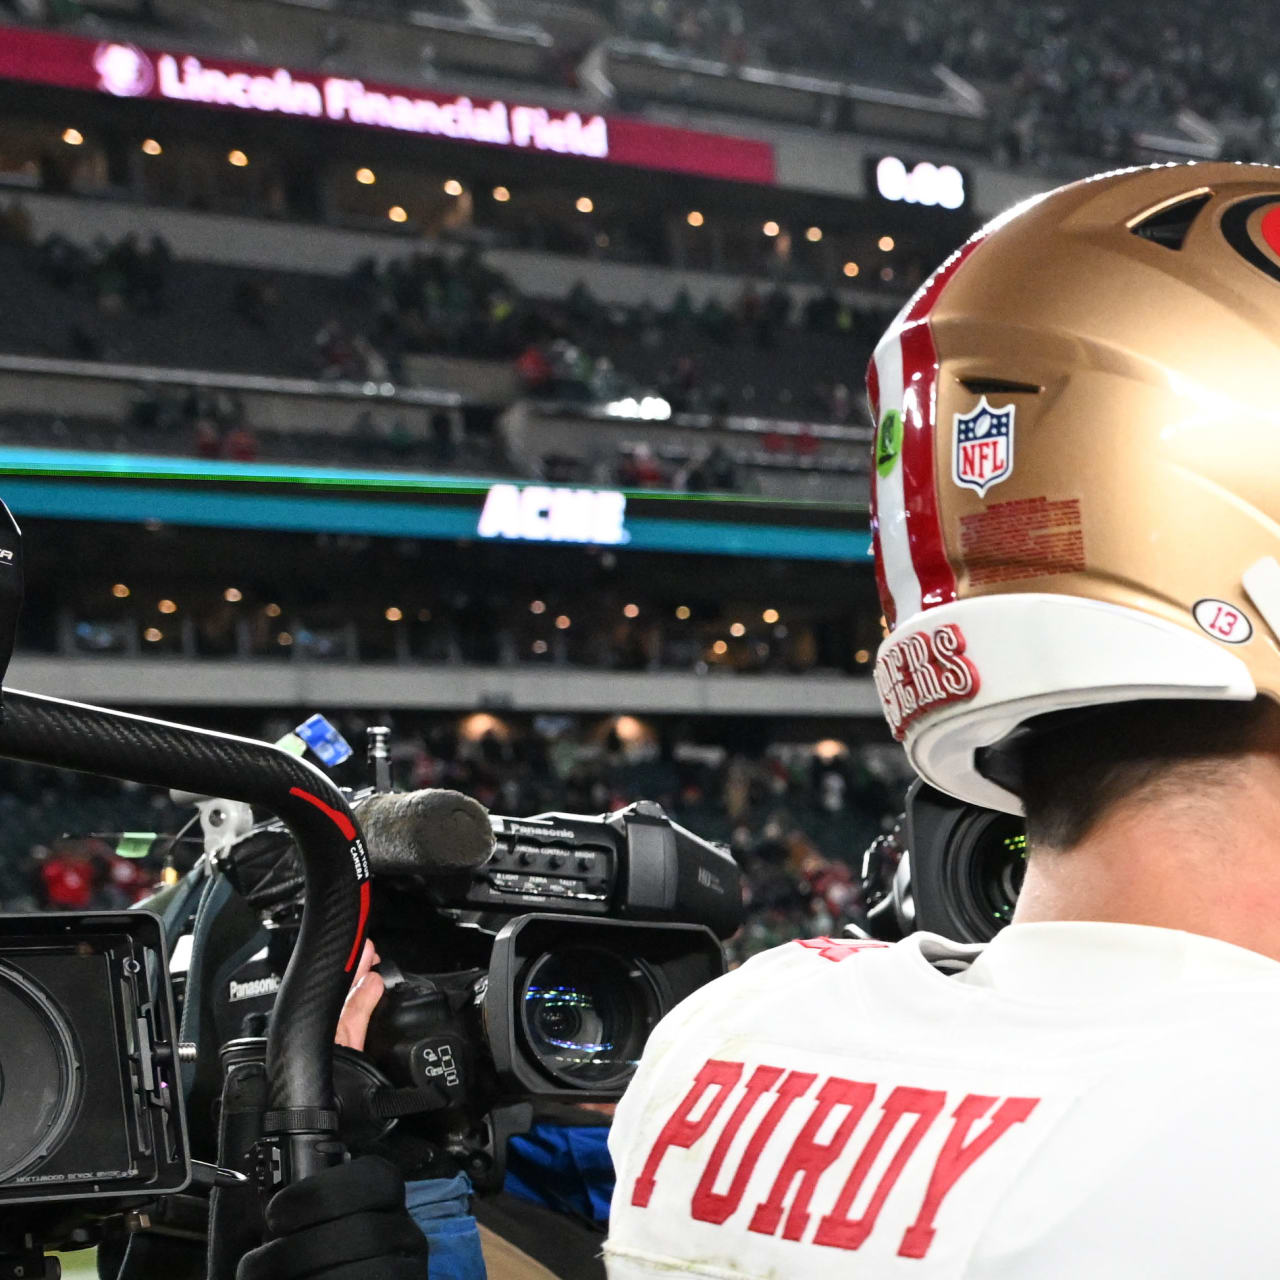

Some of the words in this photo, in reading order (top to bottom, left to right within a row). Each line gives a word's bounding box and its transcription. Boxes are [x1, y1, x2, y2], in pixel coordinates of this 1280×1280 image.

[158, 53, 323, 117] Lincoln
[323, 76, 511, 146] Financial
[511, 104, 609, 158] Field
[960, 440, 1005, 479] NFL
[1209, 606, 1239, 637] 13
[509, 823, 575, 839] Panasonic
[350, 846, 363, 881] CAMERA
[361, 855, 370, 879] YOUR
[560, 879, 577, 887] TALLY
[229, 972, 282, 1002] Panasonic
[631, 1058, 1041, 1259] PURDY
